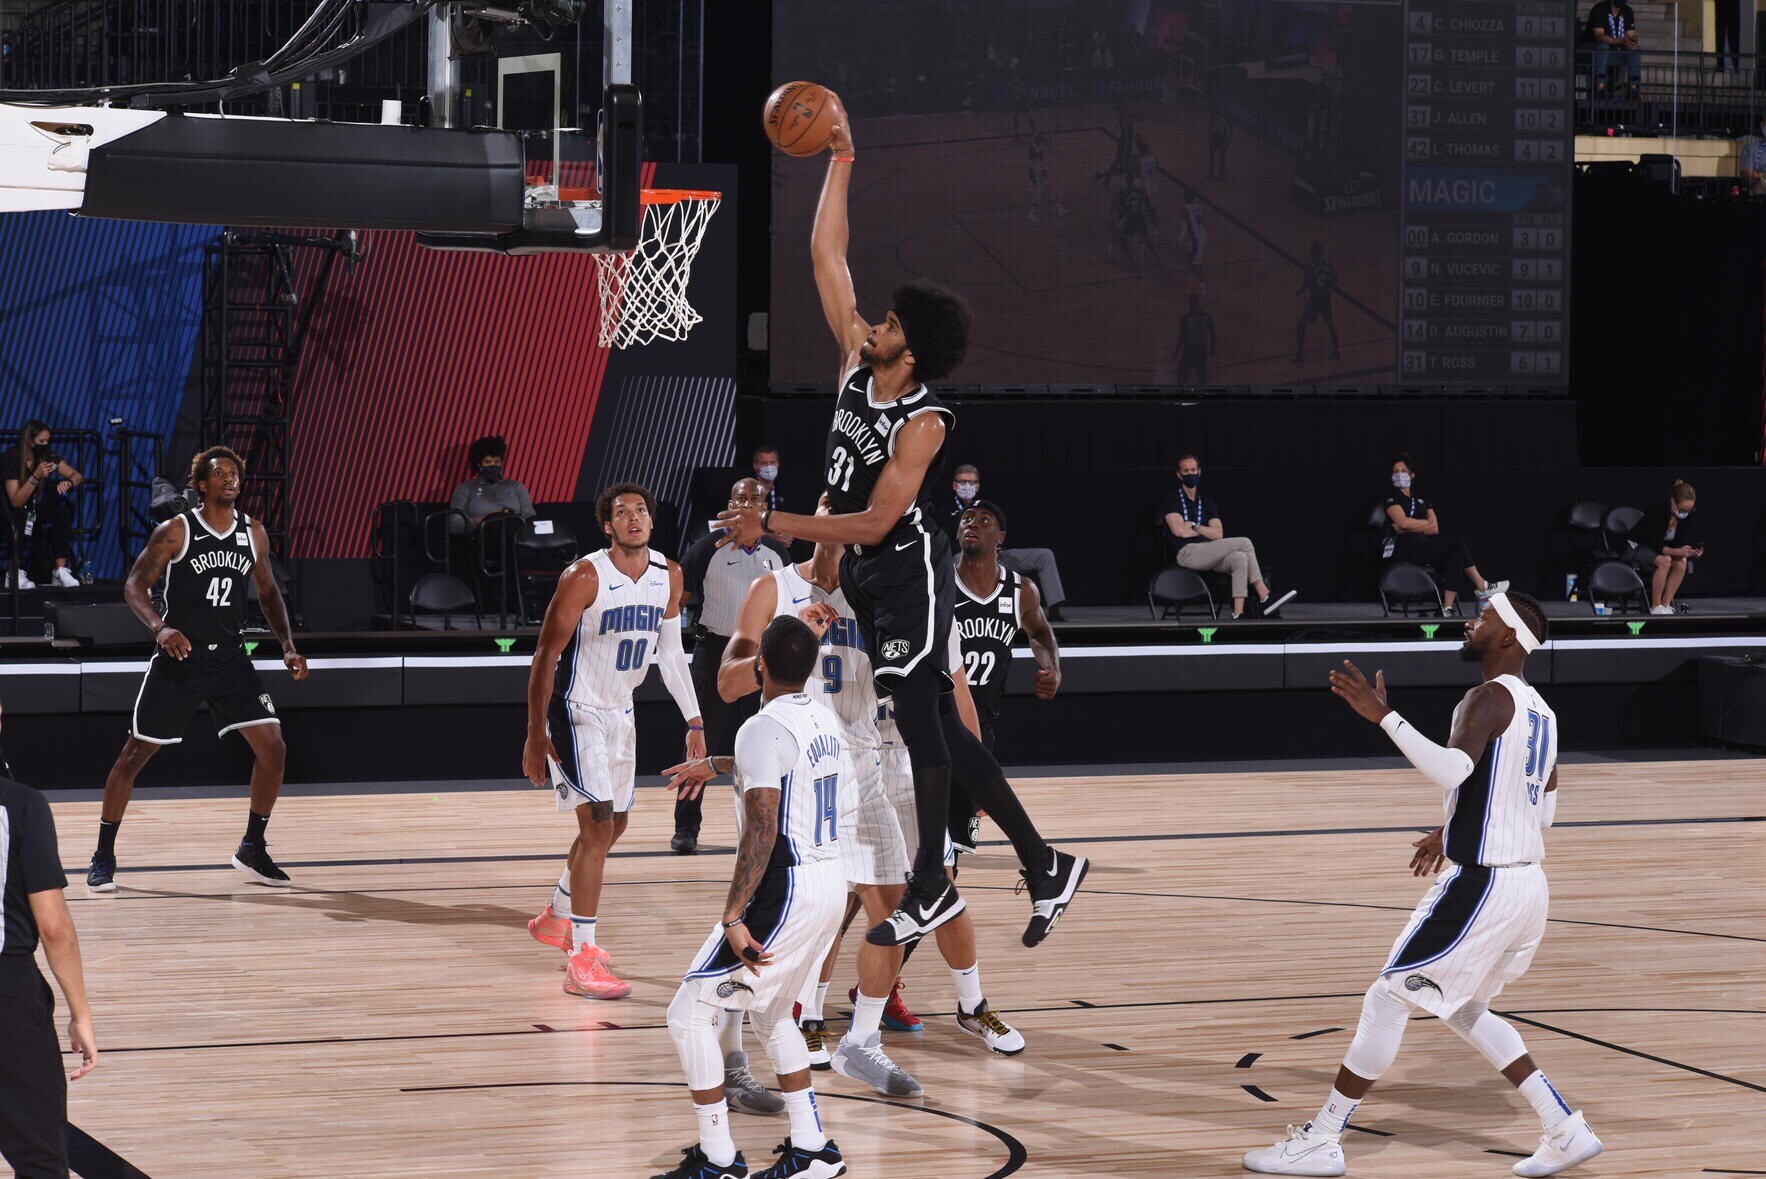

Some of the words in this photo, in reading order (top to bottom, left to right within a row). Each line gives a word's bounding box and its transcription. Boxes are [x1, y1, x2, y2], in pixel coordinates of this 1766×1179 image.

[1415, 16, 1425, 31] 4
[1450, 18, 1504, 31] CHIOZZA
[1524, 20, 1533, 34] 0
[1411, 47, 1429, 62] 17
[1450, 49, 1499, 63] TEMPLE
[1524, 50, 1532, 65] 0
[1549, 52, 1557, 66] 0
[1410, 78, 1428, 93] 22
[1449, 81, 1496, 94] LEVERT
[1520, 82, 1535, 97] 11
[1548, 83, 1557, 97] 0
[769, 83, 804, 126] SPALDING
[1409, 110, 1427, 125] 31
[1447, 112, 1487, 125] ALLEN
[1520, 113, 1536, 128] 10
[1547, 114, 1556, 128] 2
[1408, 141, 1427, 156] 42
[1446, 143, 1501, 157] THOMAS
[1522, 145, 1531, 159] 4
[1547, 145, 1556, 159] 2
[1324, 189, 1382, 214] SPALDING
[1409, 178, 1497, 205] MAGIC
[1407, 230, 1426, 244] 00
[1446, 231, 1500, 245] GORDON
[1520, 232, 1529, 246] 3
[1546, 232, 1555, 247] 0
[1411, 262, 1421, 276] 9
[1447, 263, 1501, 276] VUCEVIC
[1520, 263, 1529, 277] 9
[1407, 293, 1425, 307] 10
[1444, 294, 1505, 307] FOURNIER
[1517, 294, 1533, 309] 10
[1545, 294, 1553, 308] 0
[1407, 324, 1424, 339] 14
[1445, 325, 1508, 338] AUGUSTIN
[1519, 325, 1528, 339] 7
[1544, 326, 1553, 339] 0
[1405, 355, 1422, 370] 31
[1442, 356, 1477, 369] ROSS
[1519, 357, 1527, 370] 6
[831, 408, 885, 466] BROOKLYN
[827, 446, 855, 492] 31
[190, 550, 252, 576] BROOKLYN
[205, 577, 233, 607] 42
[599, 604, 665, 636] MAGIC
[956, 617, 1016, 647] ROOKLYN
[616, 638, 649, 672] 00
[883, 640, 909, 653] NETS
[822, 654, 843, 694] 9
[964, 651, 996, 686] 22
[806, 733, 841, 769] EQUALITY
[1525, 707, 1550, 782] 31
[813, 772, 839, 847] 14
